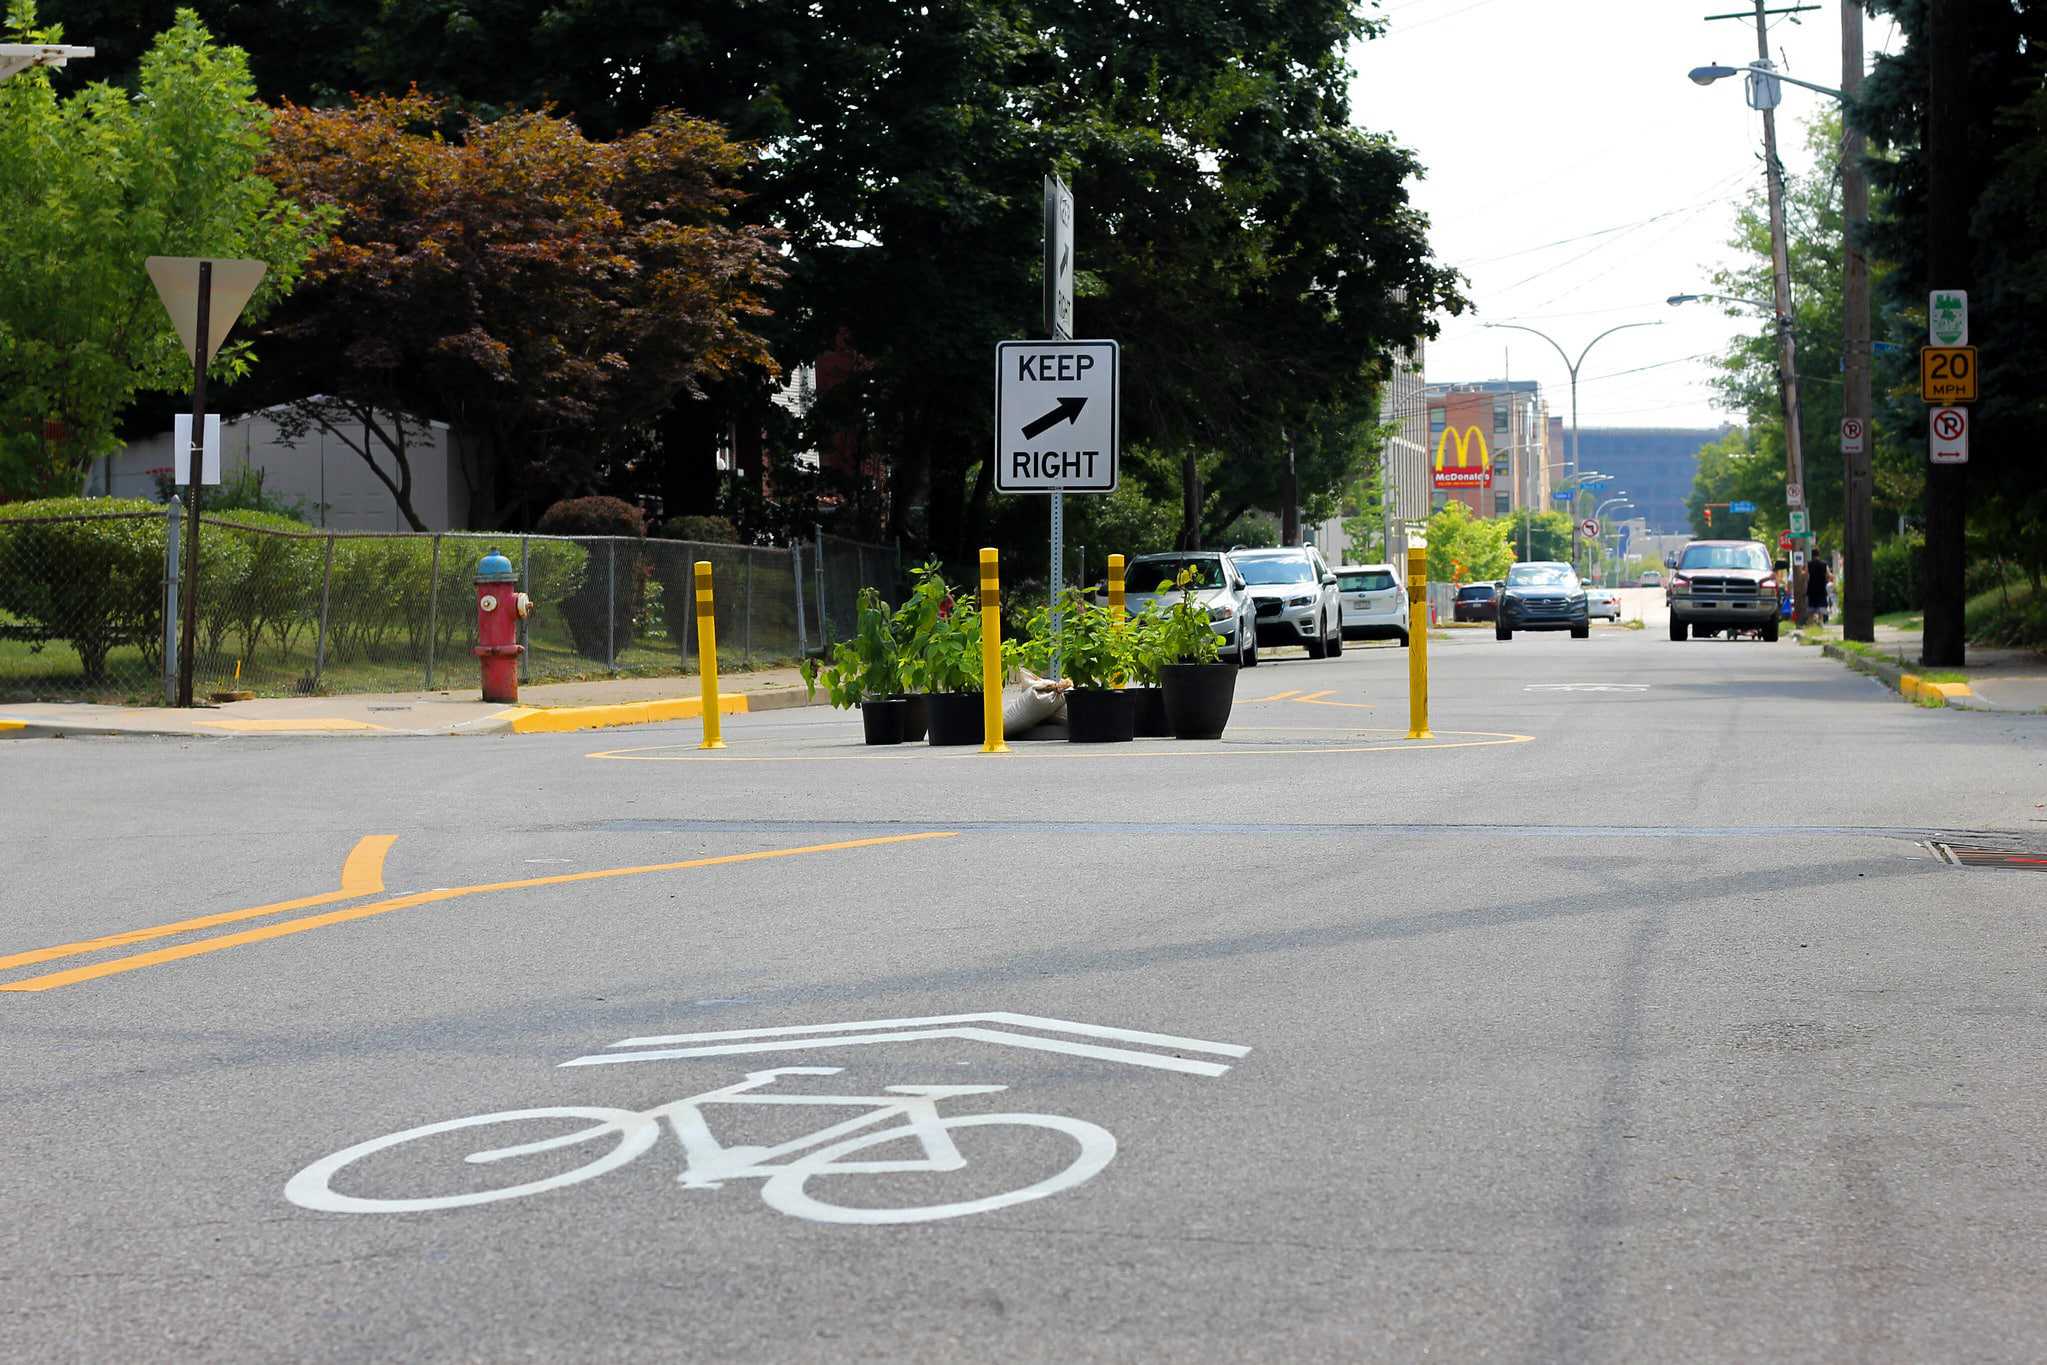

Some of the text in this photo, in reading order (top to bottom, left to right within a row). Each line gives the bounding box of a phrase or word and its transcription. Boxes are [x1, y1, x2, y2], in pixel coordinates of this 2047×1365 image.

[1018, 354, 1095, 382] KEEP
[1930, 353, 1969, 380] 20
[1933, 384, 1966, 395] MPH
[1012, 451, 1099, 480] RIGHT
[1435, 472, 1490, 481] McDonalds
